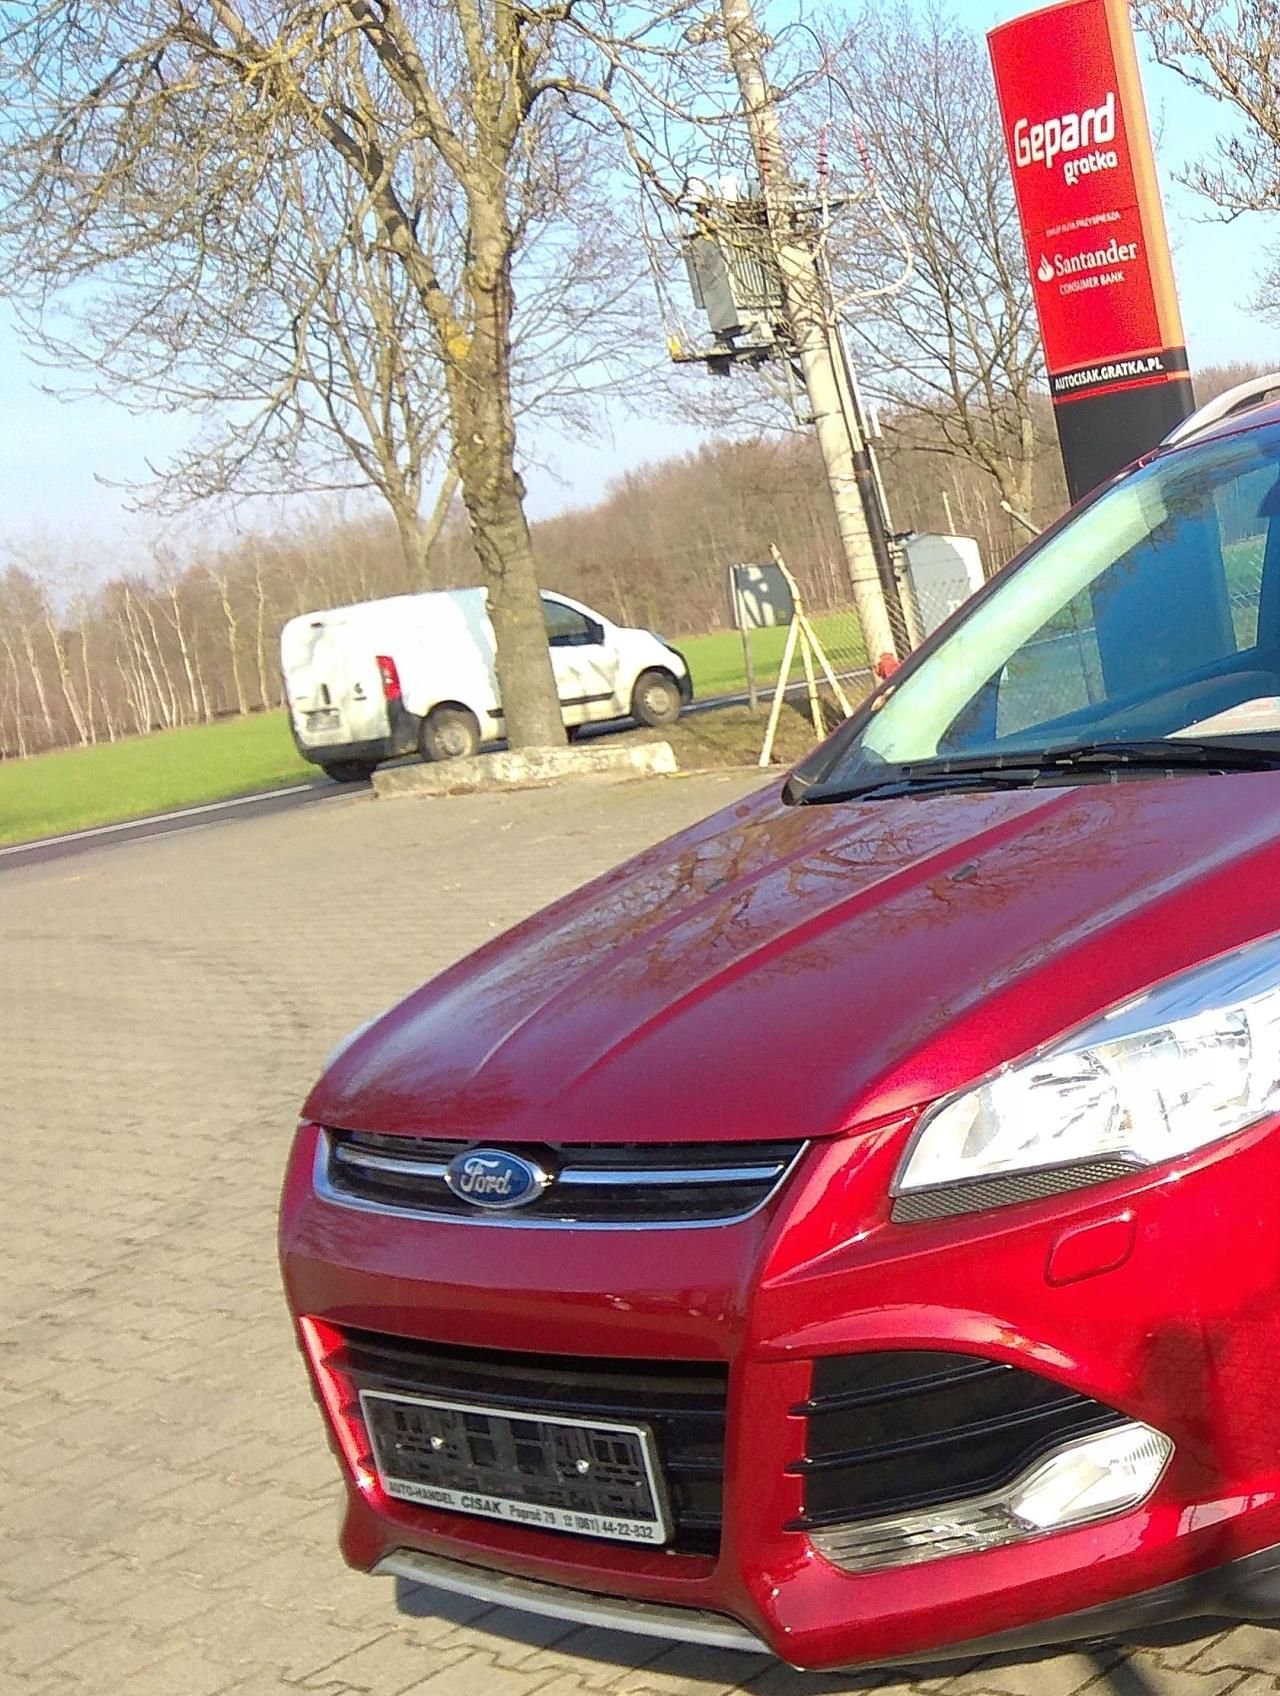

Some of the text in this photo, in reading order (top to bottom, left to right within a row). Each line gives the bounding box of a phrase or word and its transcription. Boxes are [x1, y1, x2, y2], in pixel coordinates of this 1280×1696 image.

[1014, 91, 1115, 168] Gepard
[1063, 150, 1118, 186] gratka
[1054, 238, 1137, 277] Santander
[1060, 271, 1124, 295] CONSUMER BANK
[1055, 356, 1164, 391] AUTOCISAK.GRATKA.PL
[460, 1157, 513, 1195] Ford
[389, 1481, 455, 1506] AUTO-HANDEL
[461, 1495, 502, 1514] CISAK
